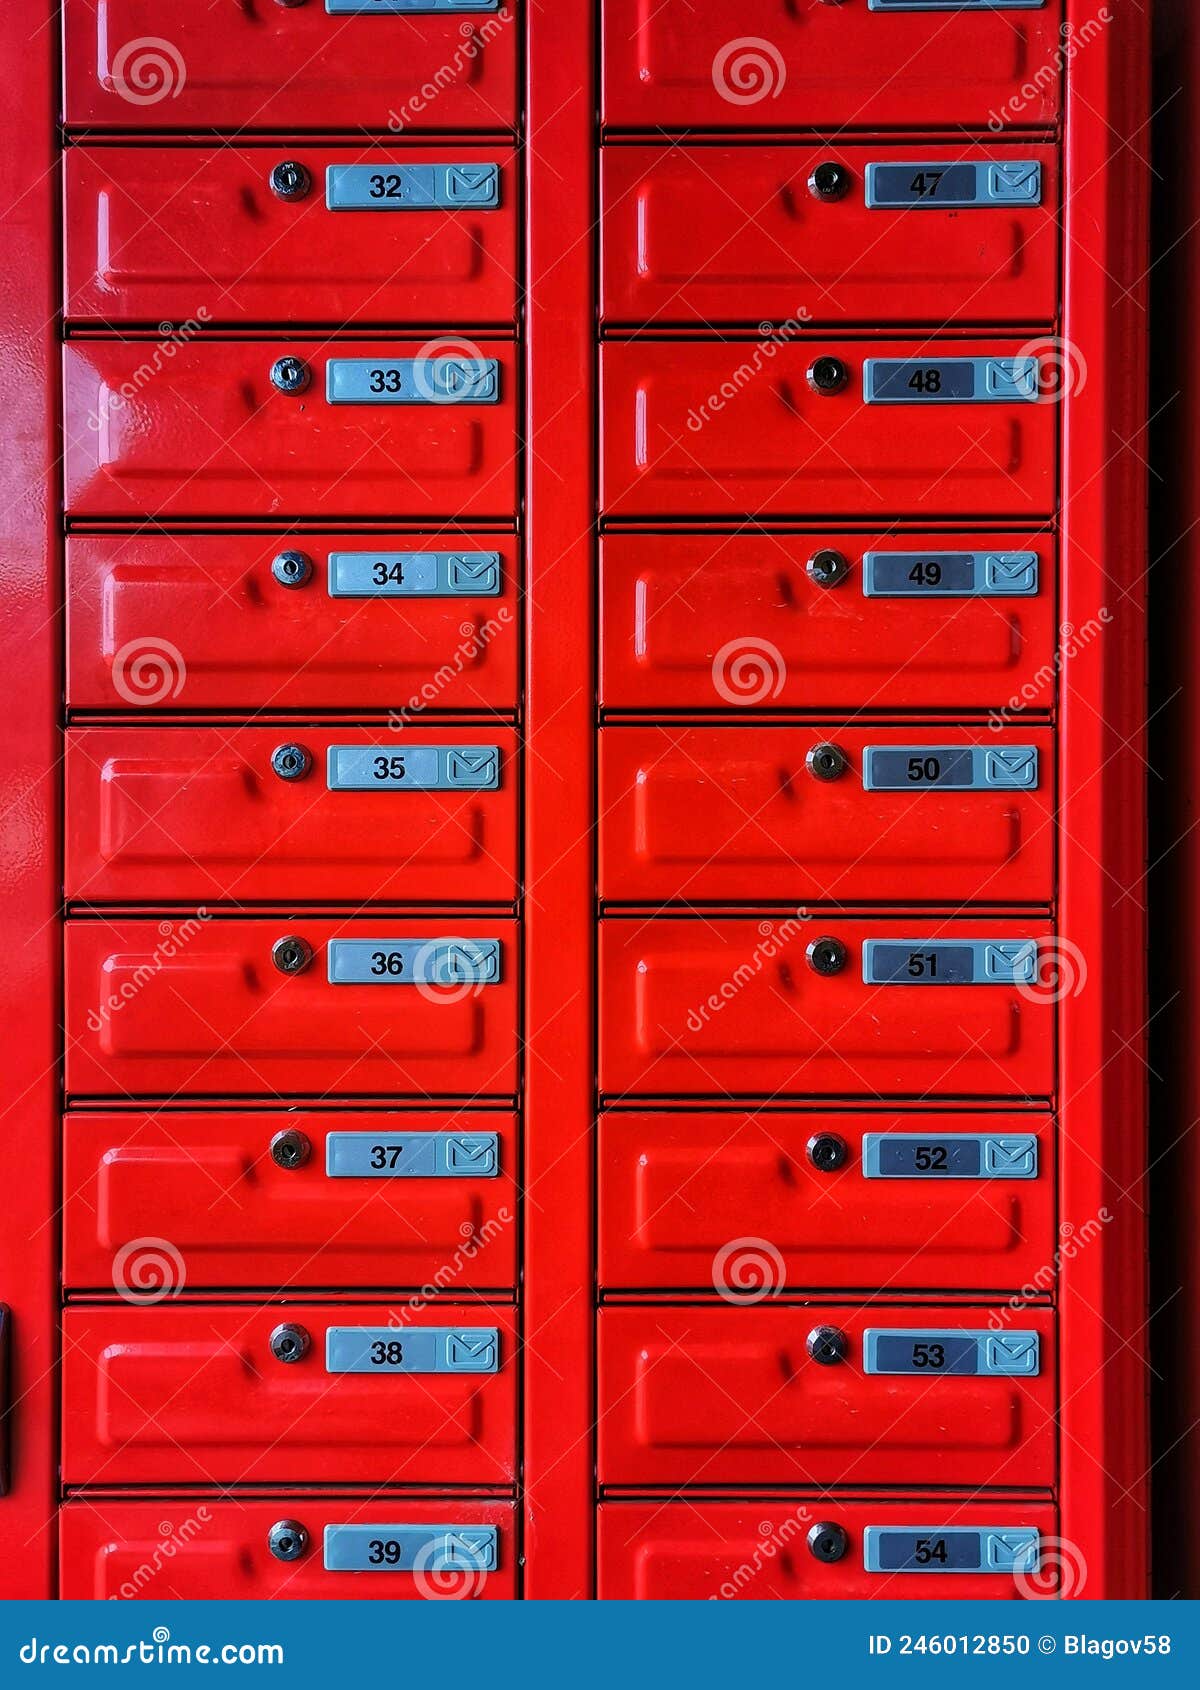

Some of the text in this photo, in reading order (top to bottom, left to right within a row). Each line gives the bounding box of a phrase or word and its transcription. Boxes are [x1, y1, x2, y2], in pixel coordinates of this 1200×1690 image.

[370, 175, 401, 198] 32
[911, 173, 943, 196] 47
[370, 370, 401, 392] 33
[909, 370, 941, 392] 48
[373, 563, 404, 585] 34
[909, 563, 941, 585] 49
[374, 757, 405, 779] 35
[908, 758, 940, 780] 50
[371, 952, 403, 975] 36
[909, 954, 936, 976] 51
[371, 1146, 402, 1169] 37
[916, 1147, 947, 1170] 52
[371, 1341, 402, 1364] 38
[913, 1344, 944, 1368] 53
[369, 1541, 401, 1564] 39
[916, 1540, 947, 1563] 54
